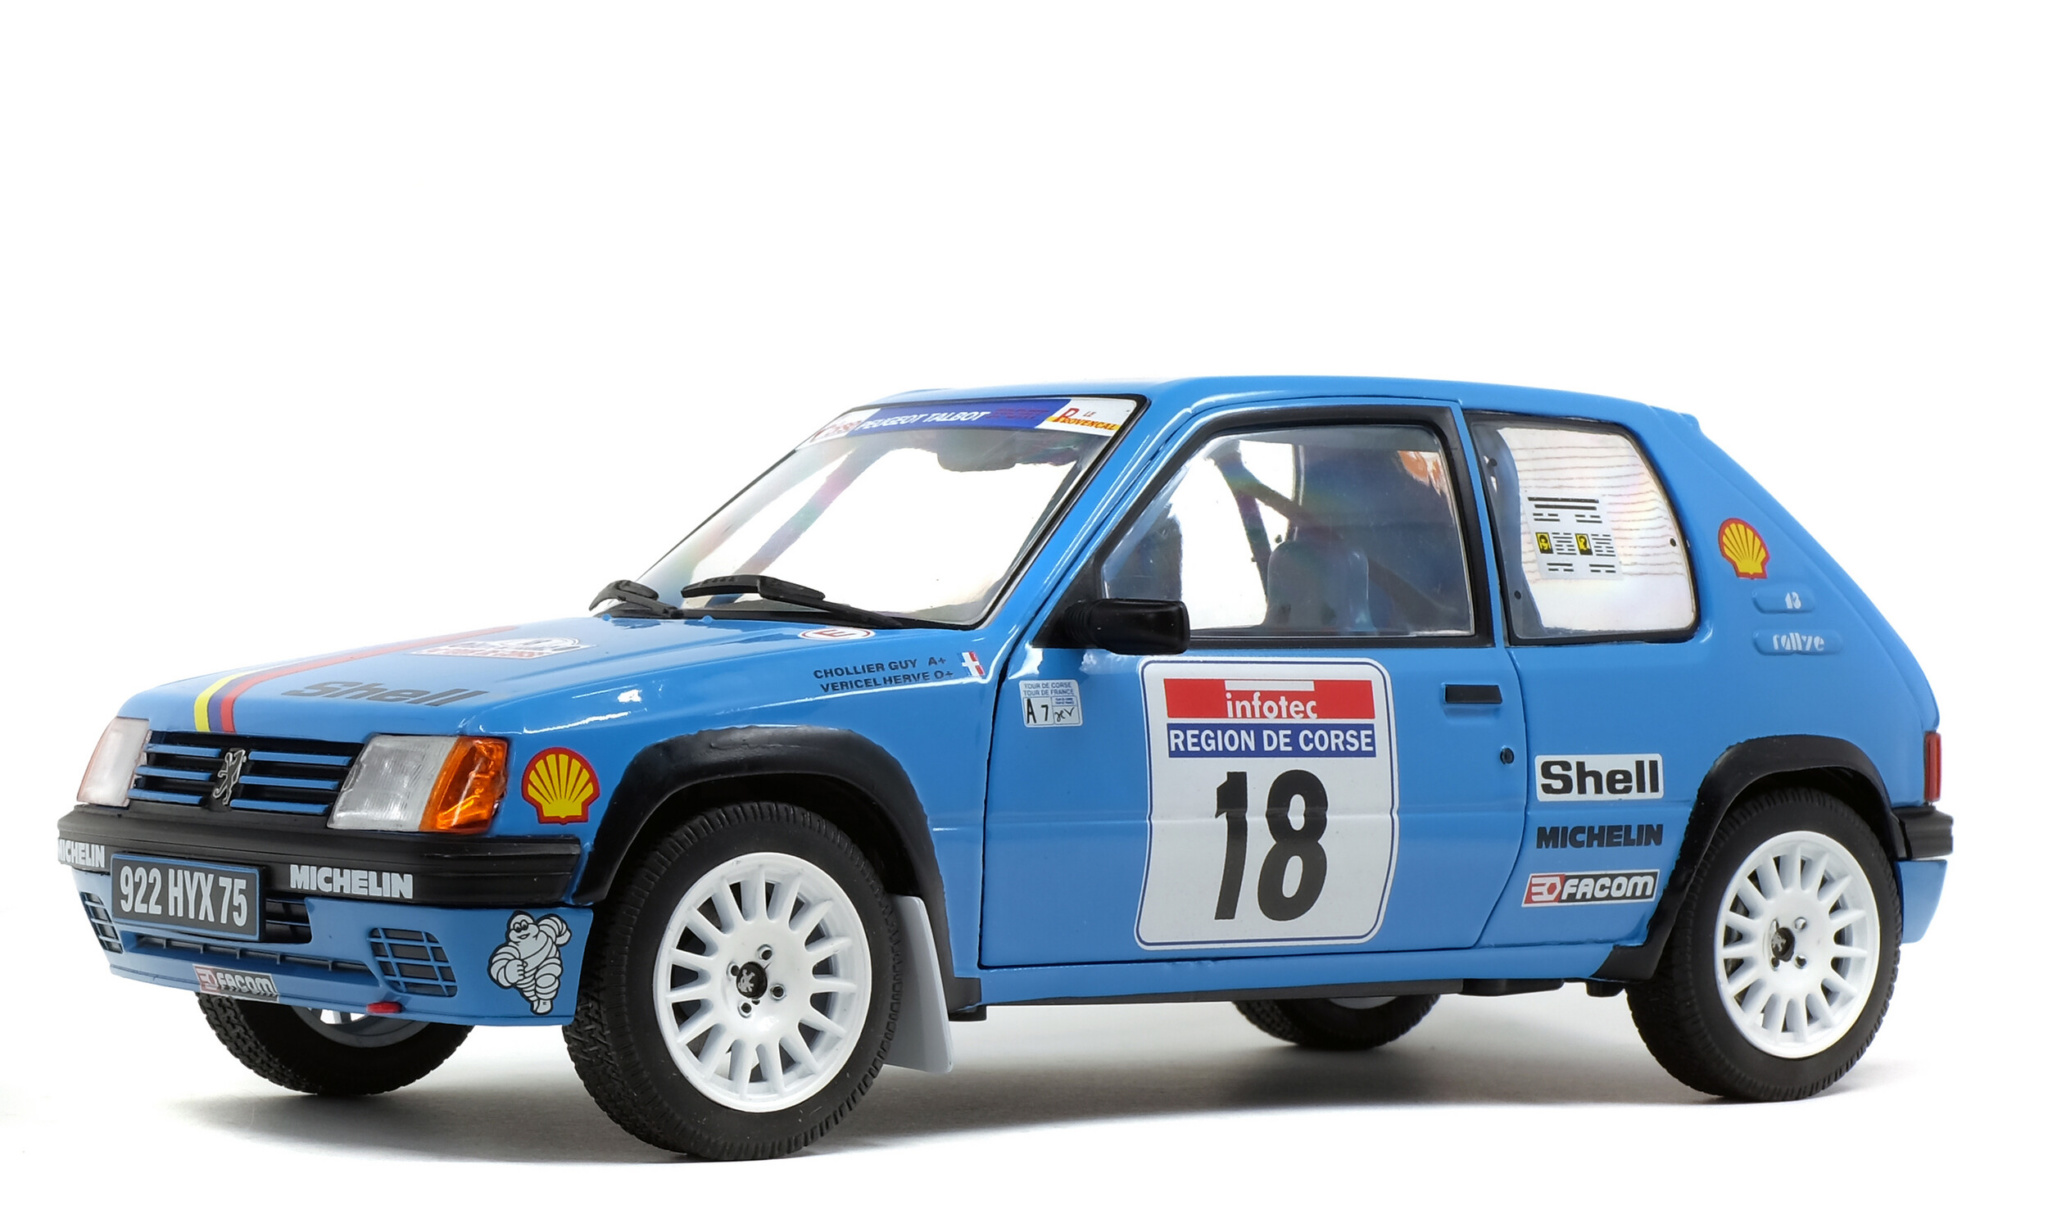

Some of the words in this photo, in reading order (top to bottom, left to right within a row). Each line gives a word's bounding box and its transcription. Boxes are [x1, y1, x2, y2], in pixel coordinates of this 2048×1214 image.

[855, 414, 928, 431] PEUGEOT
[922, 411, 991, 423] TALBOT
[813, 662, 886, 680] CHOLLIER
[888, 658, 918, 671] GUY
[928, 656, 947, 667] A+
[281, 681, 490, 707] Shell
[820, 678, 882, 693] VERICEL
[883, 671, 930, 686] HERVE
[1050, 681, 1072, 689] CORSE
[1050, 688, 1074, 696] FRANCE
[1226, 691, 1318, 720] infotec
[1169, 729, 1256, 751] REGION
[1263, 730, 1293, 751] DE
[1299, 729, 1374, 751] CORSE
[1540, 760, 1660, 795] Shell
[1214, 769, 1328, 922] 18
[1536, 824, 1664, 849] MICHELIN
[290, 864, 414, 900] MICHELIN
[1561, 875, 1655, 900] FACOM
[120, 865, 162, 915] 922
[168, 868, 215, 922] HYX
[219, 876, 248, 927] 75
[216, 972, 280, 997] FACOM
